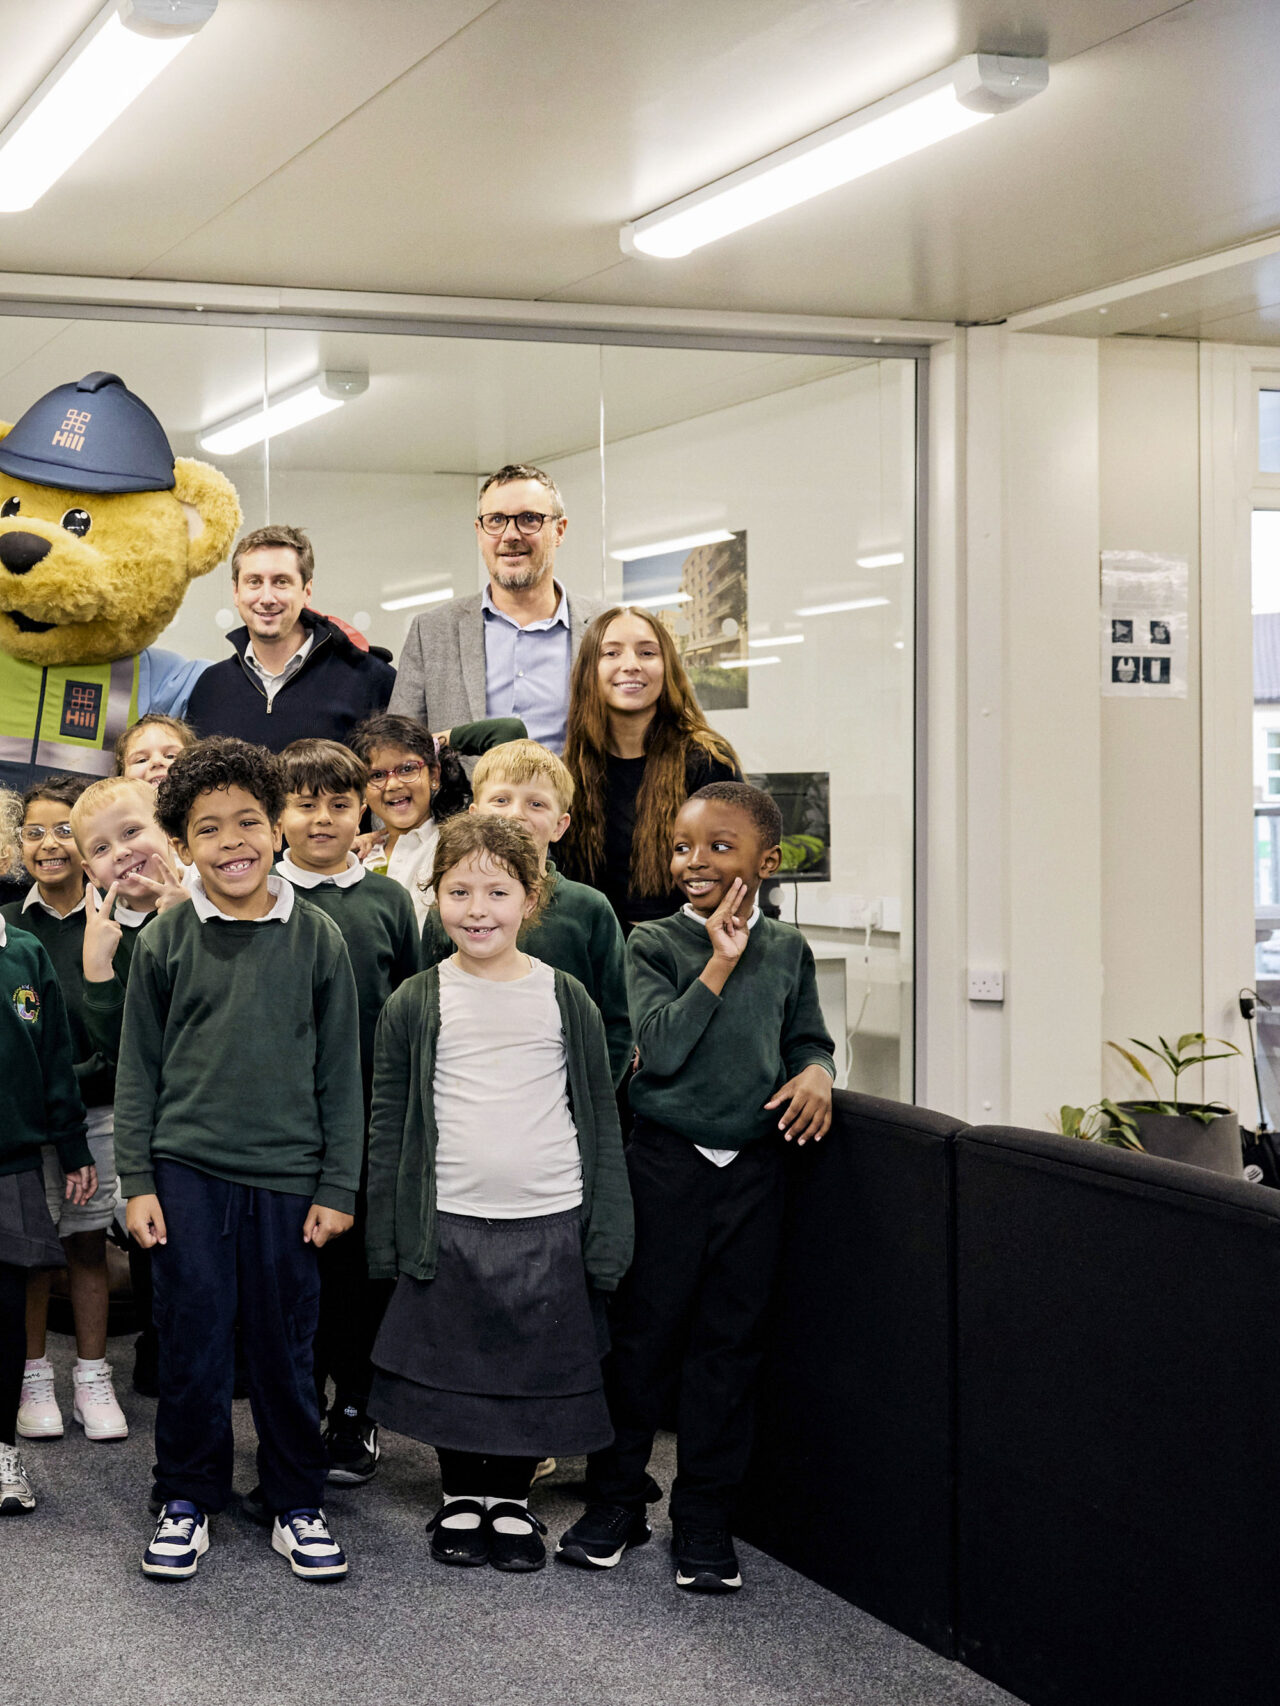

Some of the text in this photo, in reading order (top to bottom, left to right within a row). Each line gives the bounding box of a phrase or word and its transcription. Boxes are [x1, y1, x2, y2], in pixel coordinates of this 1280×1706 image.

[52, 430, 85, 451] Hill
[66, 710, 96, 728] Hill
[17, 989, 36, 1020] C
